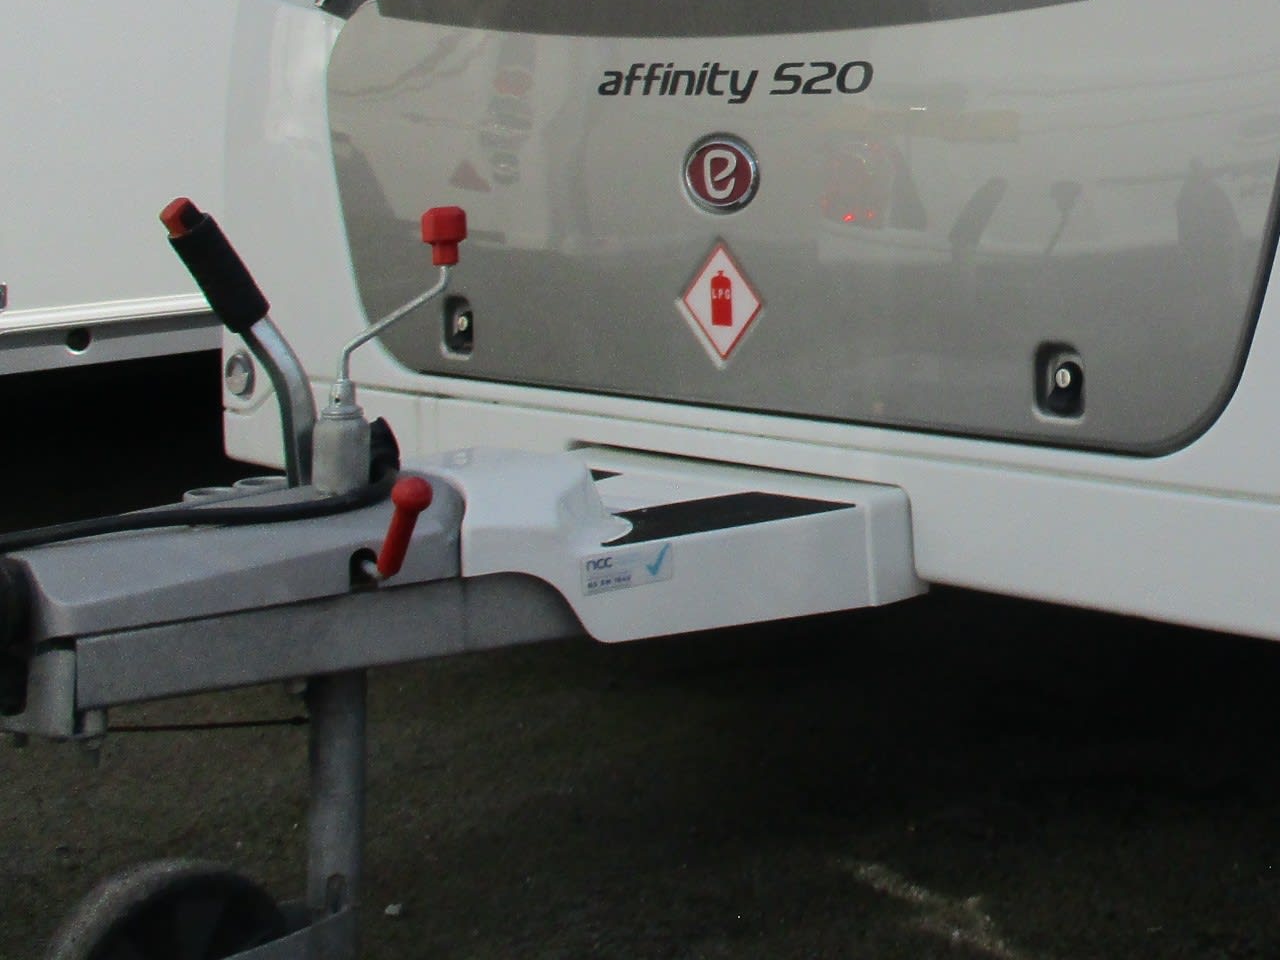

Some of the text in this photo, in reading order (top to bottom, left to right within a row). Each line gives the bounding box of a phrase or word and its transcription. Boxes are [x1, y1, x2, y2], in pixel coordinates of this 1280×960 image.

[597, 60, 874, 105] affinity S20
[711, 288, 732, 301] LPG
